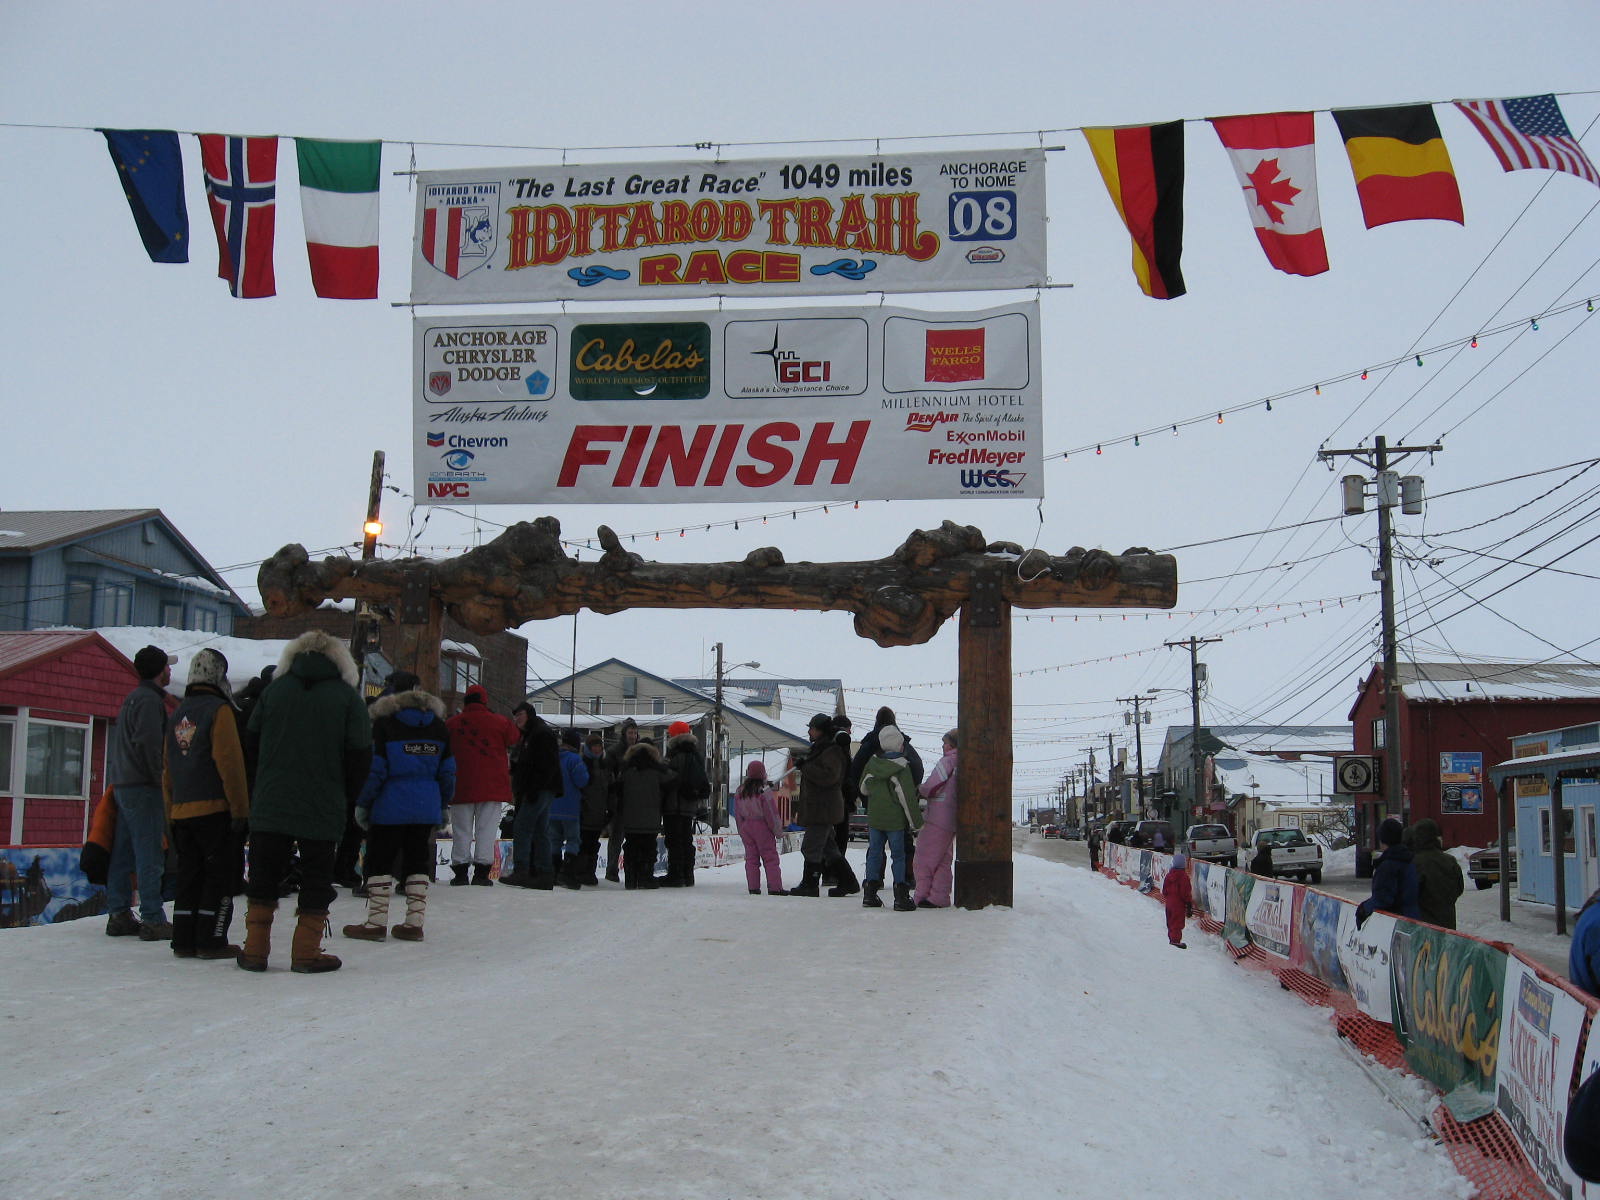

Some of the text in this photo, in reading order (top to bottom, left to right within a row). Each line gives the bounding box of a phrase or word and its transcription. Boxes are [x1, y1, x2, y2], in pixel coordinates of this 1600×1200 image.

[779, 162, 913, 190] 1049 miles
[939, 160, 1028, 176] ANCHORAGE
[428, 184, 497, 197] IDITAROD TRAIL
[564, 177, 615, 198] Last
[625, 174, 690, 196] Great
[950, 175, 1016, 189] TO NOME
[445, 195, 478, 206] ALASKA
[504, 191, 941, 271] IDITAROD TRAIL
[639, 249, 801, 286] RACE
[433, 330, 548, 348] ANCHORAGE
[442, 348, 537, 365] CHRYSLER
[575, 338, 705, 372] Cabela's
[930, 344, 982, 356] WELLS
[930, 355, 981, 367] FARGO
[457, 366, 521, 383] DODGE
[779, 361, 831, 383] GCI
[881, 395, 1025, 409] MILLENNIUM HOTEL
[429, 405, 550, 424] Alaska Airlines
[448, 434, 509, 448] Chevron
[946, 430, 1026, 445] ExxonMobil
[556, 420, 872, 488] FINISH
[427, 482, 470, 498] NAC
